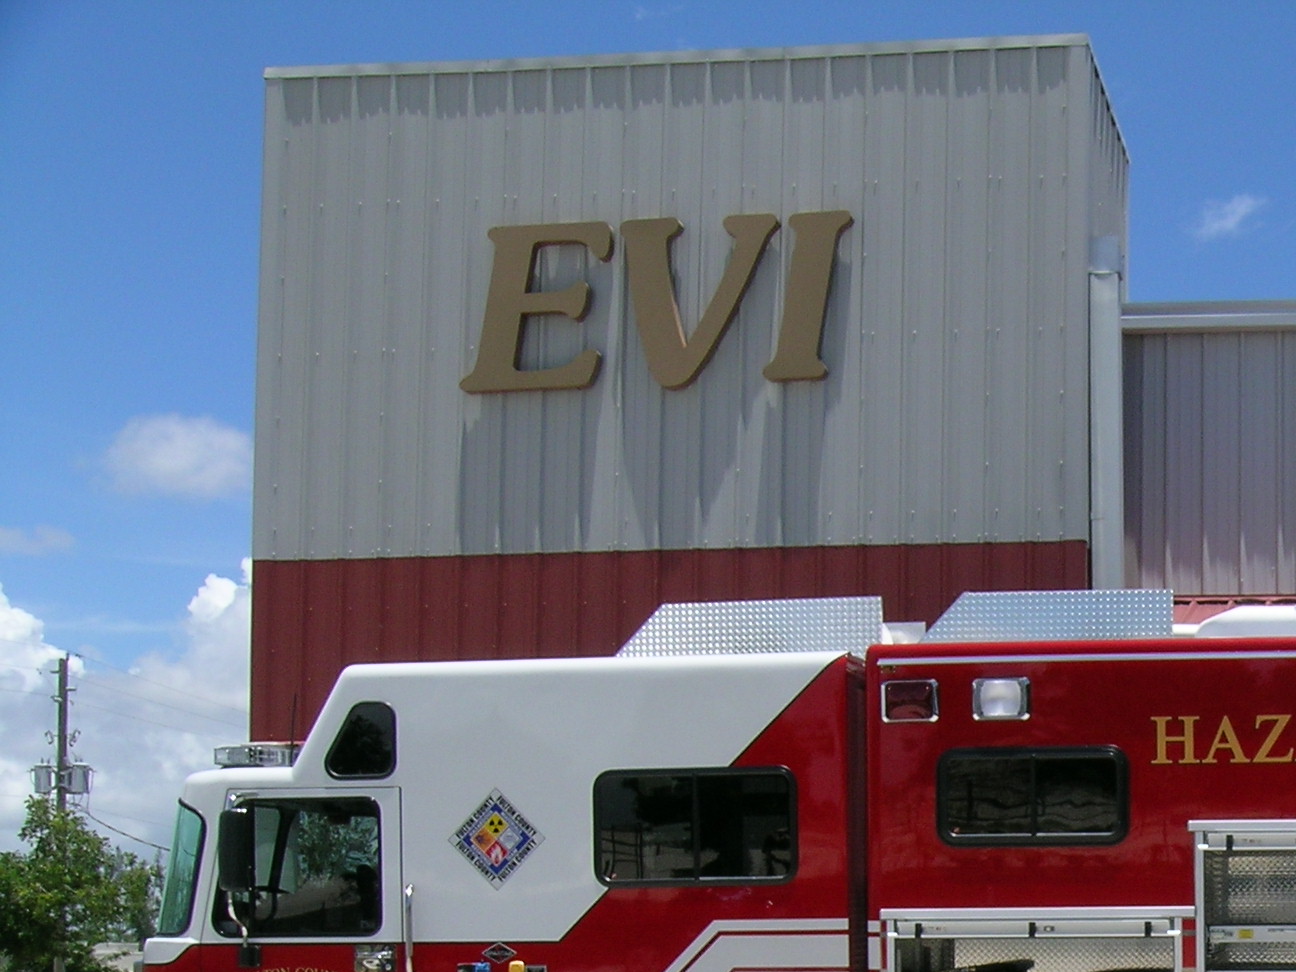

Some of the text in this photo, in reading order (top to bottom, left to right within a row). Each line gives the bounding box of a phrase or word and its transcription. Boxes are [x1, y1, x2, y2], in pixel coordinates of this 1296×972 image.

[459, 210, 854, 395] EVI
[455, 817, 475, 839] FULTON
[473, 796, 495, 820] COUNTY
[496, 795, 516, 816] FULTON
[515, 814, 537, 838] COUNTY
[456, 840, 475, 861] FULTON
[474, 859, 496, 881] COUNTY
[497, 861, 517, 882] FULTON
[515, 839, 537, 863] COUNTY
